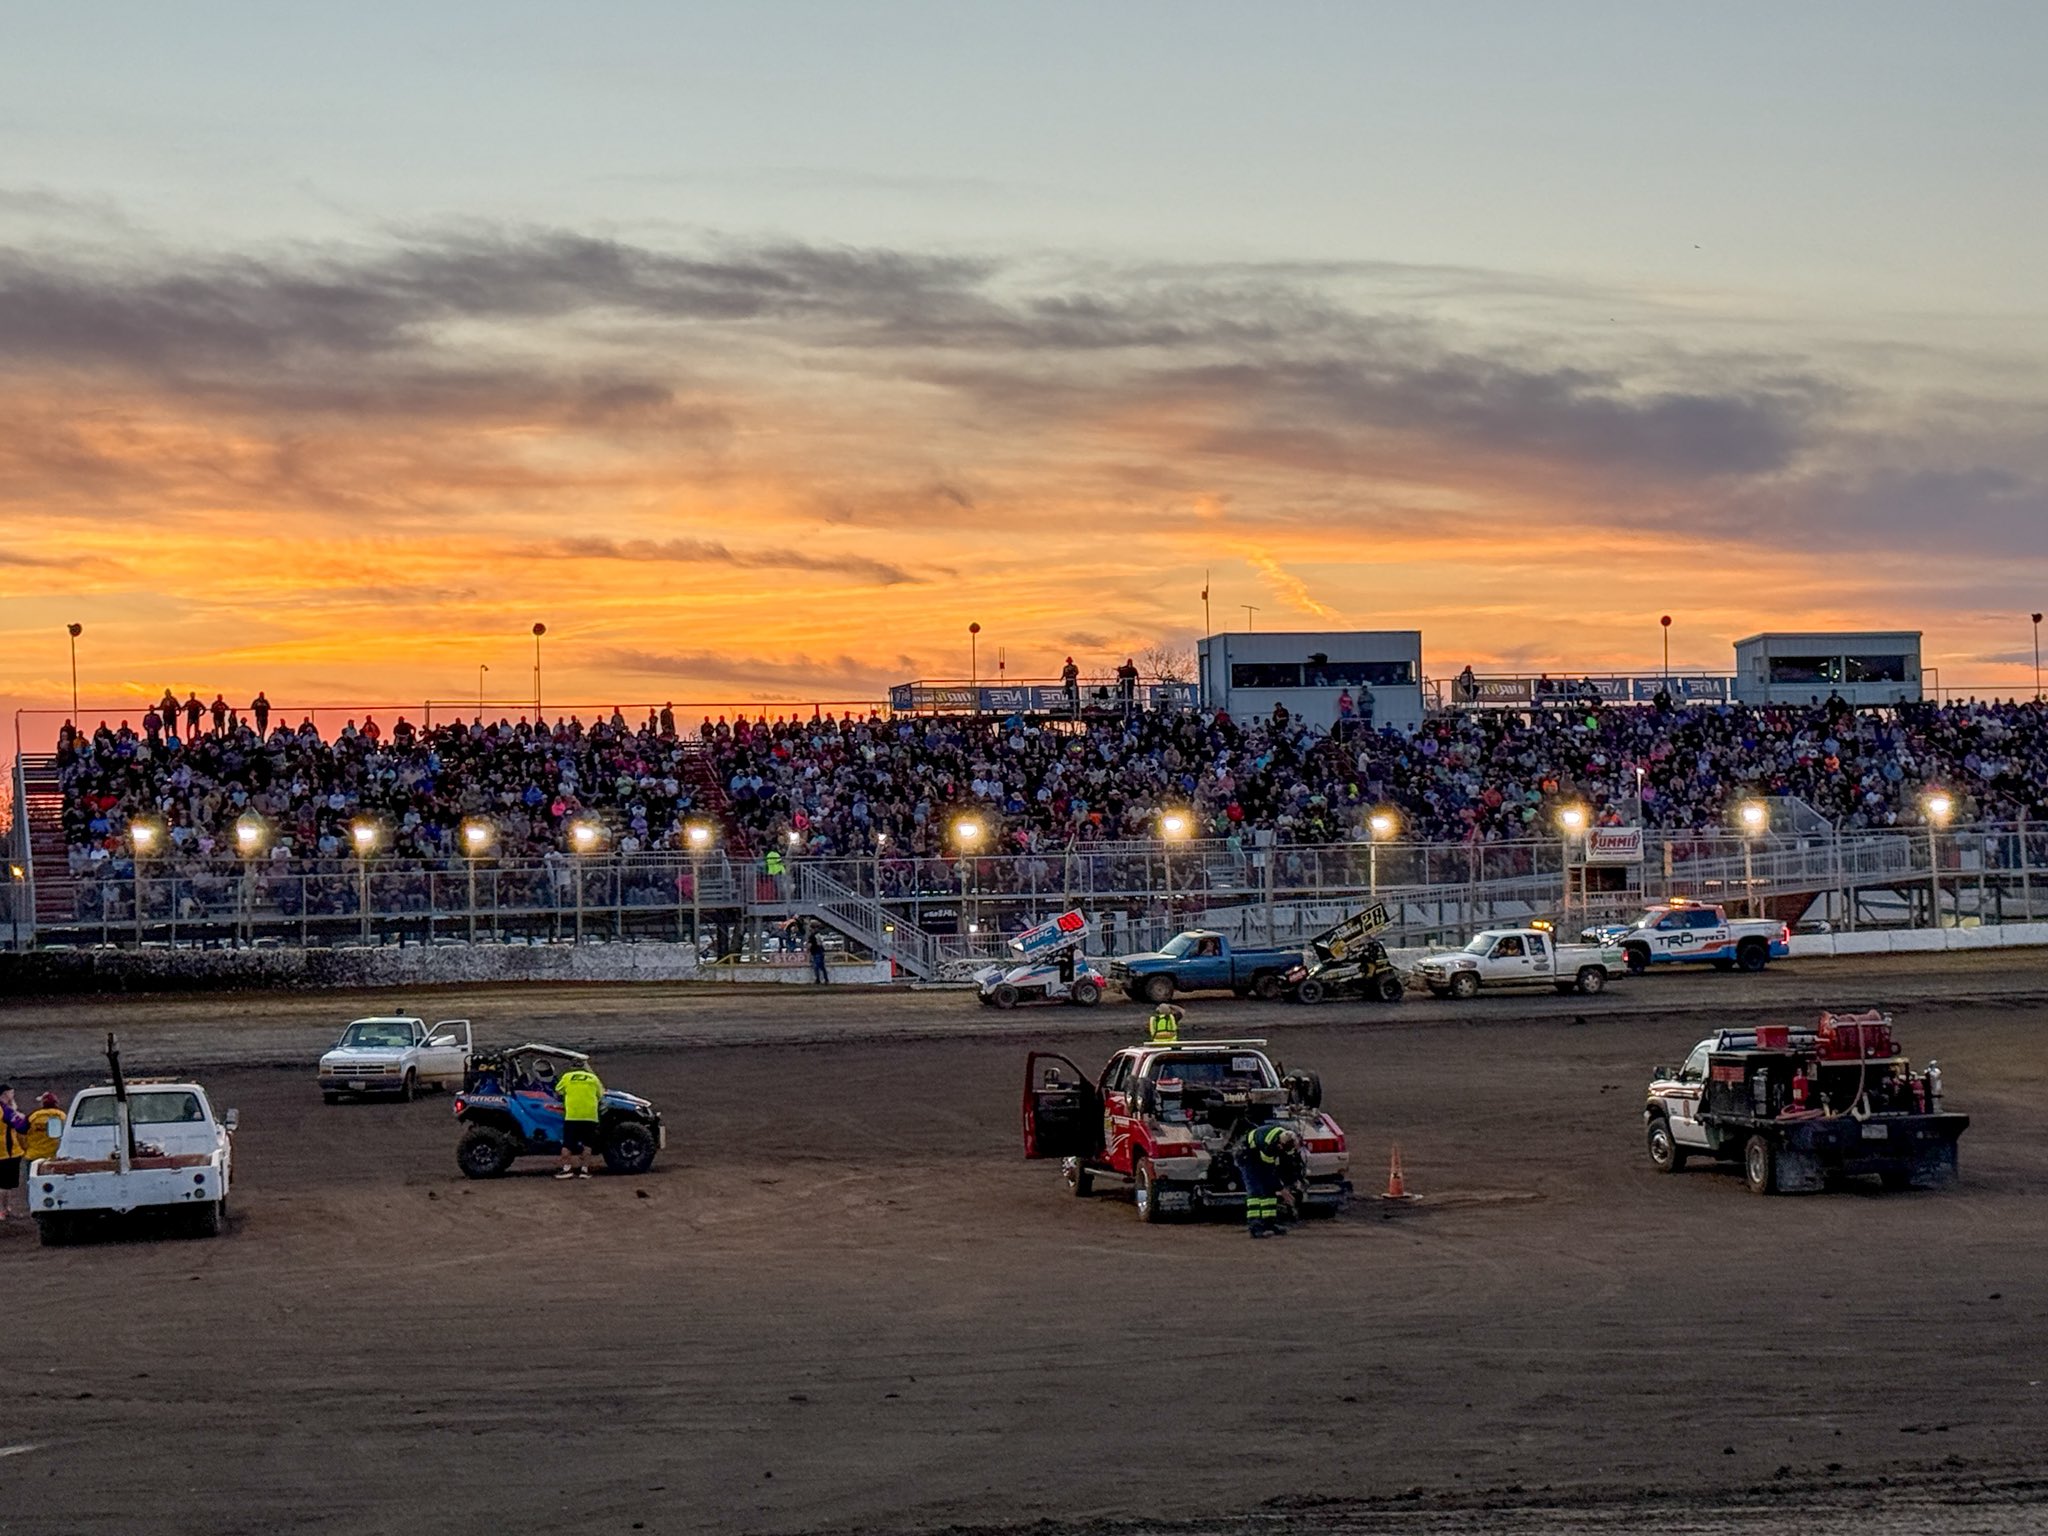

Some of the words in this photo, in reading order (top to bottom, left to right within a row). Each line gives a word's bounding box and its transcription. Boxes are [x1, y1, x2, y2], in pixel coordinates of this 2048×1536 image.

[1588, 830, 1640, 851] SUMMIT
[1025, 928, 1053, 945] MPC
[1655, 933, 1694, 948] TRD
[774, 955, 806, 963] STOP
[470, 1095, 504, 1104] OFFICIAL
